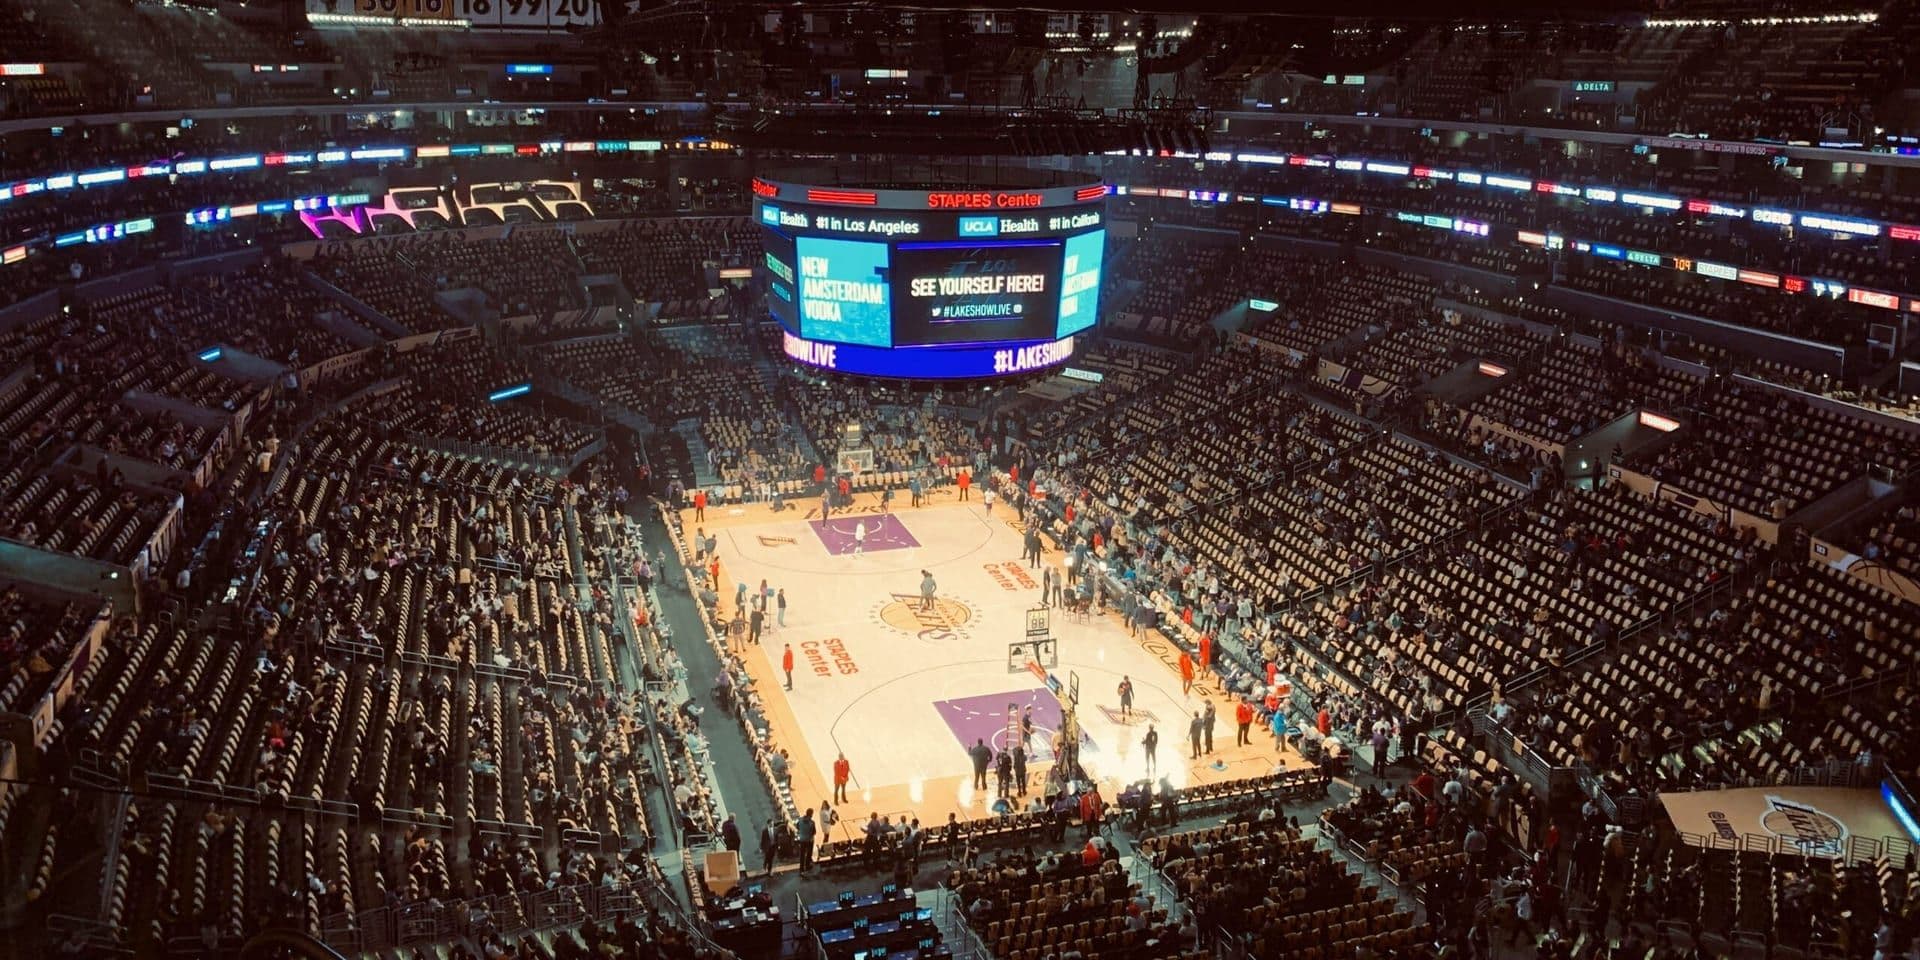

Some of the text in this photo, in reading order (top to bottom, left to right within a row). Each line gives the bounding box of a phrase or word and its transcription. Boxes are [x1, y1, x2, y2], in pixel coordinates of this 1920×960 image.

[1584, 83, 1609, 91] DELTA
[928, 192, 1042, 208] STAPLES Center
[780, 211, 808, 227] Health
[816, 216, 829, 230] #1
[831, 217, 842, 230] in
[844, 218, 866, 233] Los
[868, 219, 920, 236] Angeles
[964, 220, 993, 232] UCLA
[1000, 218, 1039, 233] Health
[1049, 217, 1061, 231] #1
[1062, 216, 1070, 230] in
[801, 256, 829, 278] NEW
[1633, 253, 1660, 266] DELTA
[911, 274, 1044, 298] SEE YOURSELF HERE!
[804, 298, 842, 322] VODKA
[943, 304, 1011, 318] #LAKESHOWLIVE
[982, 563, 1017, 592] Center
[1002, 561, 1039, 590] STAPLES
[800, 640, 832, 678] Center
[823, 637, 859, 676] STAPLES
